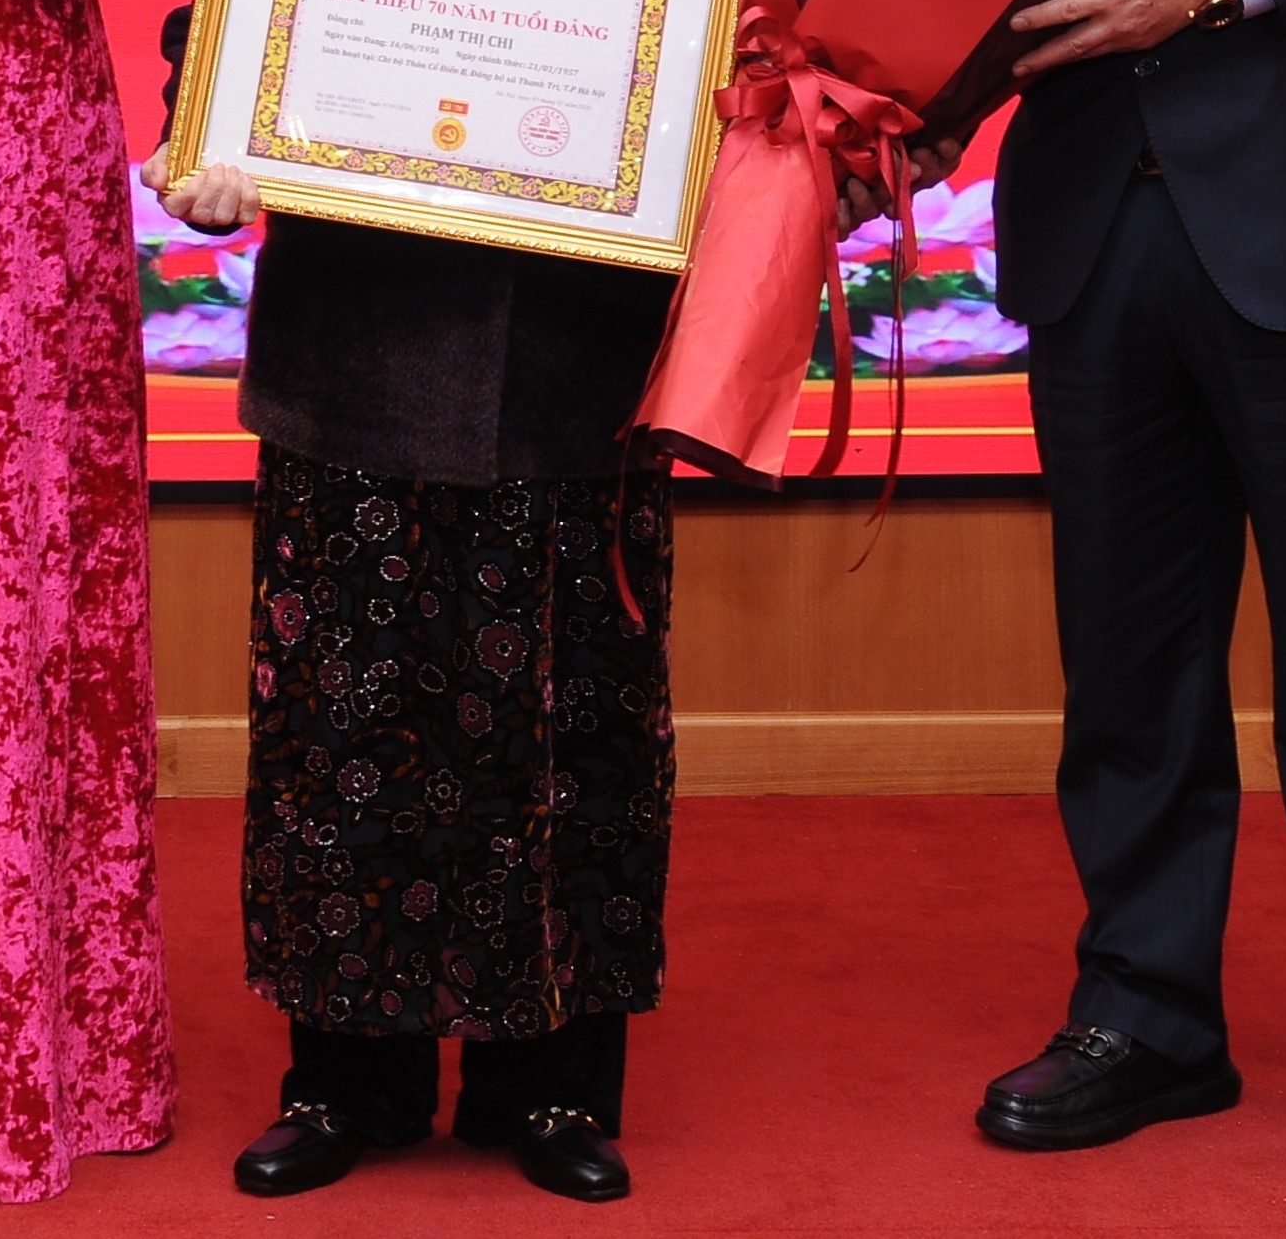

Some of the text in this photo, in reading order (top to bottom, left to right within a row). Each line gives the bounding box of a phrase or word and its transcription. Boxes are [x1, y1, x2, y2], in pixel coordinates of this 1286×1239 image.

[410, 23, 514, 50] PHẠM THỊ CHI
[428, 0, 447, 15] 70
[451, 3, 496, 23] NĂM
[502, 10, 549, 31] TUỔI
[554, 18, 609, 41] ĐẢNG
